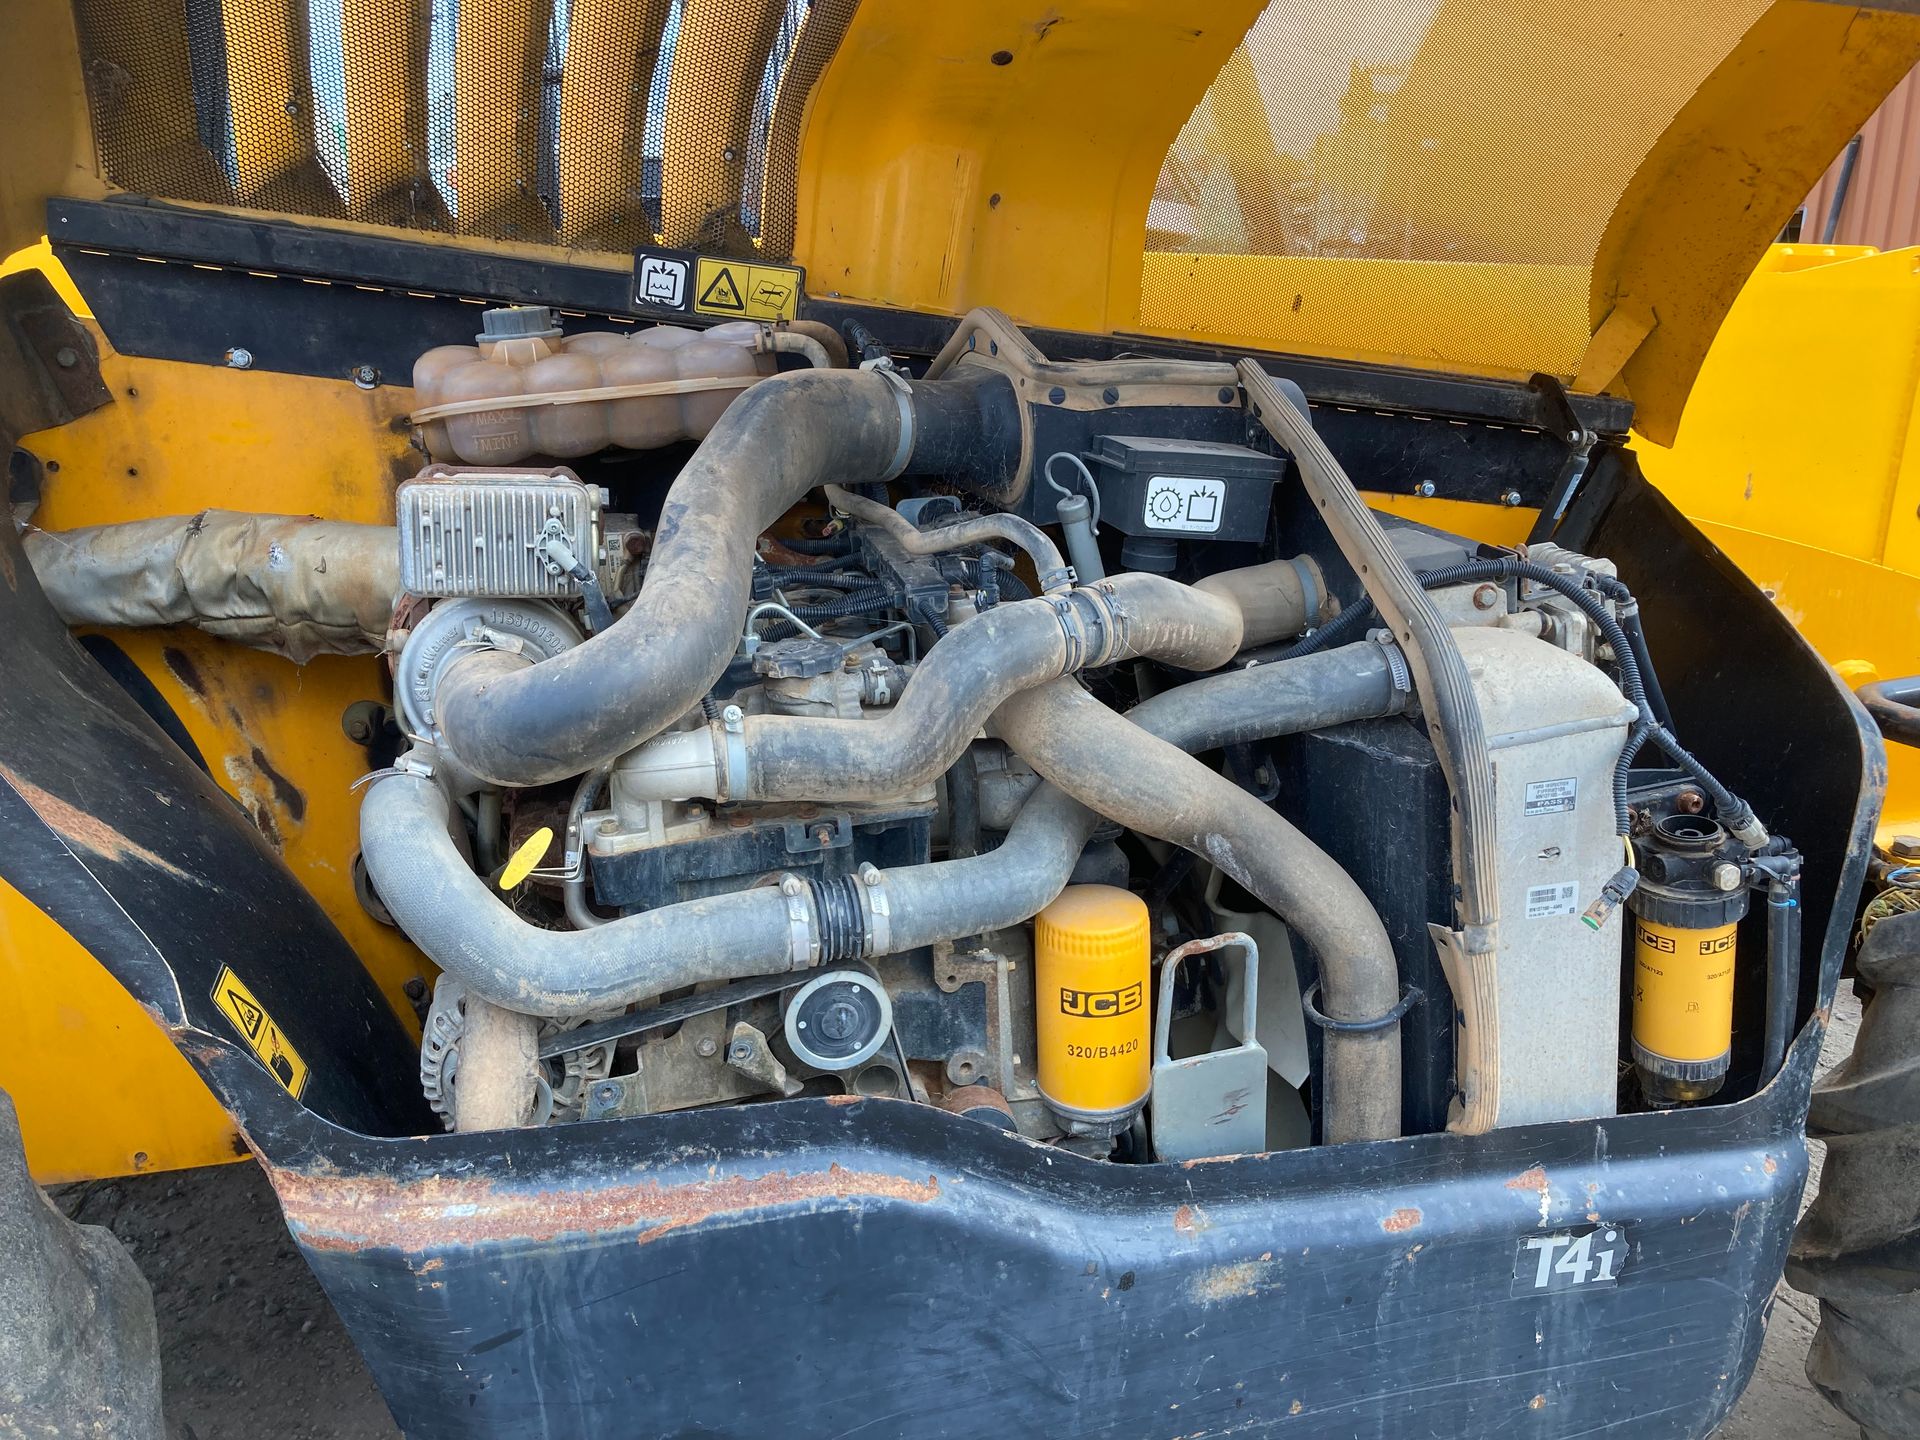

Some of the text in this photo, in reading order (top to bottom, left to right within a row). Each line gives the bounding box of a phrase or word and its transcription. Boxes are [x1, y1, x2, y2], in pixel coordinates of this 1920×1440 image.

[481, 436, 511, 451] MIN
[415, 626, 459, 687] BorgWarner
[1537, 799, 1563, 807] PASS
[1061, 982, 1142, 1017] JCB
[1067, 1038, 1138, 1059] 320/B4420
[1526, 1230, 1618, 1289] T4i
